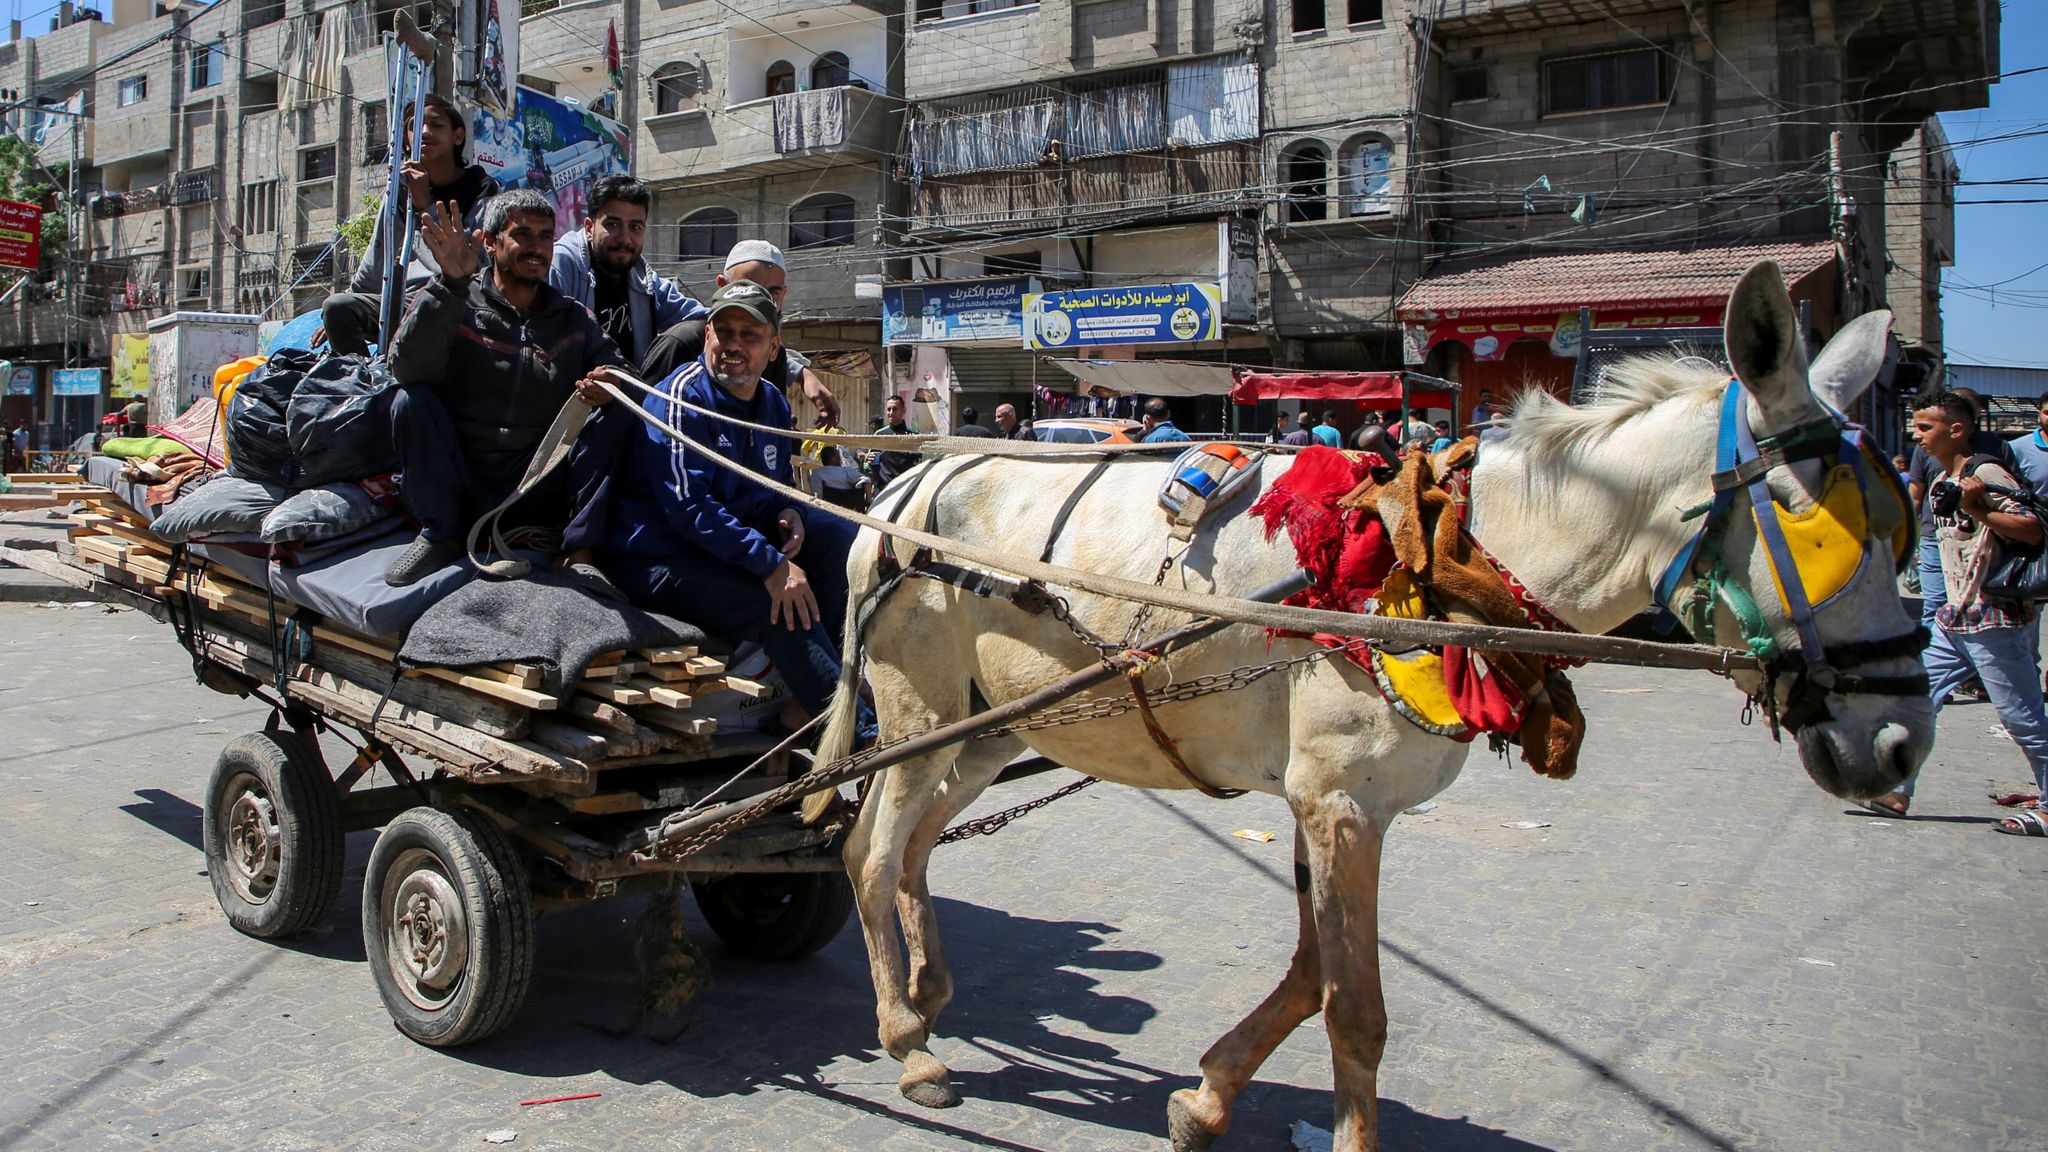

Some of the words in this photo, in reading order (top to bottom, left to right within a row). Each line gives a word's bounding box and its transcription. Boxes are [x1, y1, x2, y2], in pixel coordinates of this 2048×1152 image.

[477, 153, 505, 168] صنعتم
[1231, 229, 1255, 246] منصور
[731, 285, 756, 294] NIKE
[987, 284, 1016, 299] الزعيم
[1175, 287, 1190, 306] أبو
[1058, 294, 1099, 312] الصحية
[1101, 289, 1142, 310] للأدوات
[1144, 291, 1172, 308] صيام
